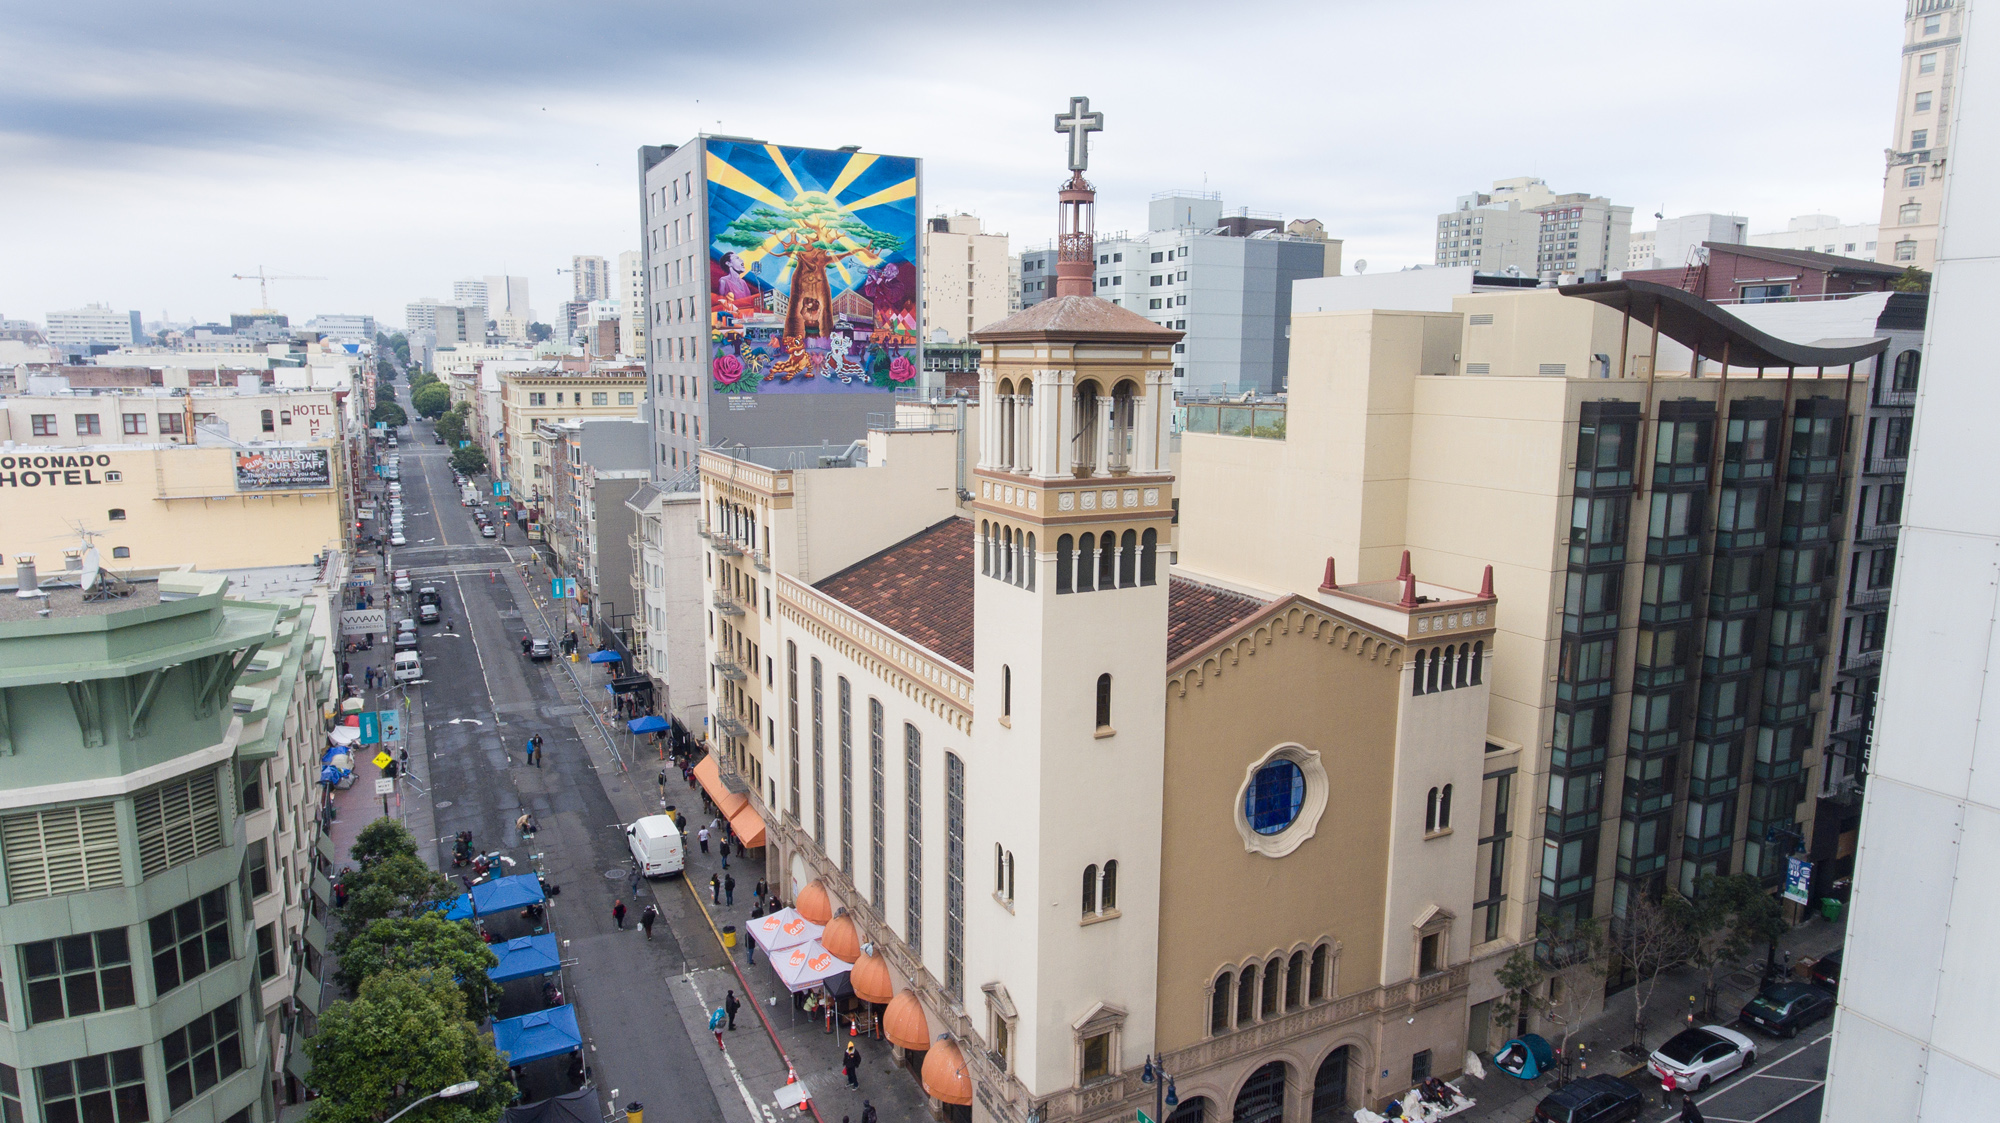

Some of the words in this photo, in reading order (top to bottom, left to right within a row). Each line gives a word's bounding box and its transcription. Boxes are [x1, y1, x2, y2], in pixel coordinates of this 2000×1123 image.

[293, 404, 332, 416] HOTEL
[245, 458, 263, 469] GLIDE
[271, 454, 288, 462] WE
[291, 453, 318, 461] LOVE
[267, 462, 290, 470] OUR
[293, 461, 324, 469] STAFF
[0, 469, 101, 487] HOTEL
[1861, 691, 1878, 774] TILDEN
[763, 922, 779, 930] GLIDE
[789, 920, 805, 935] GLIDE
[814, 955, 832, 971] GLIDE
